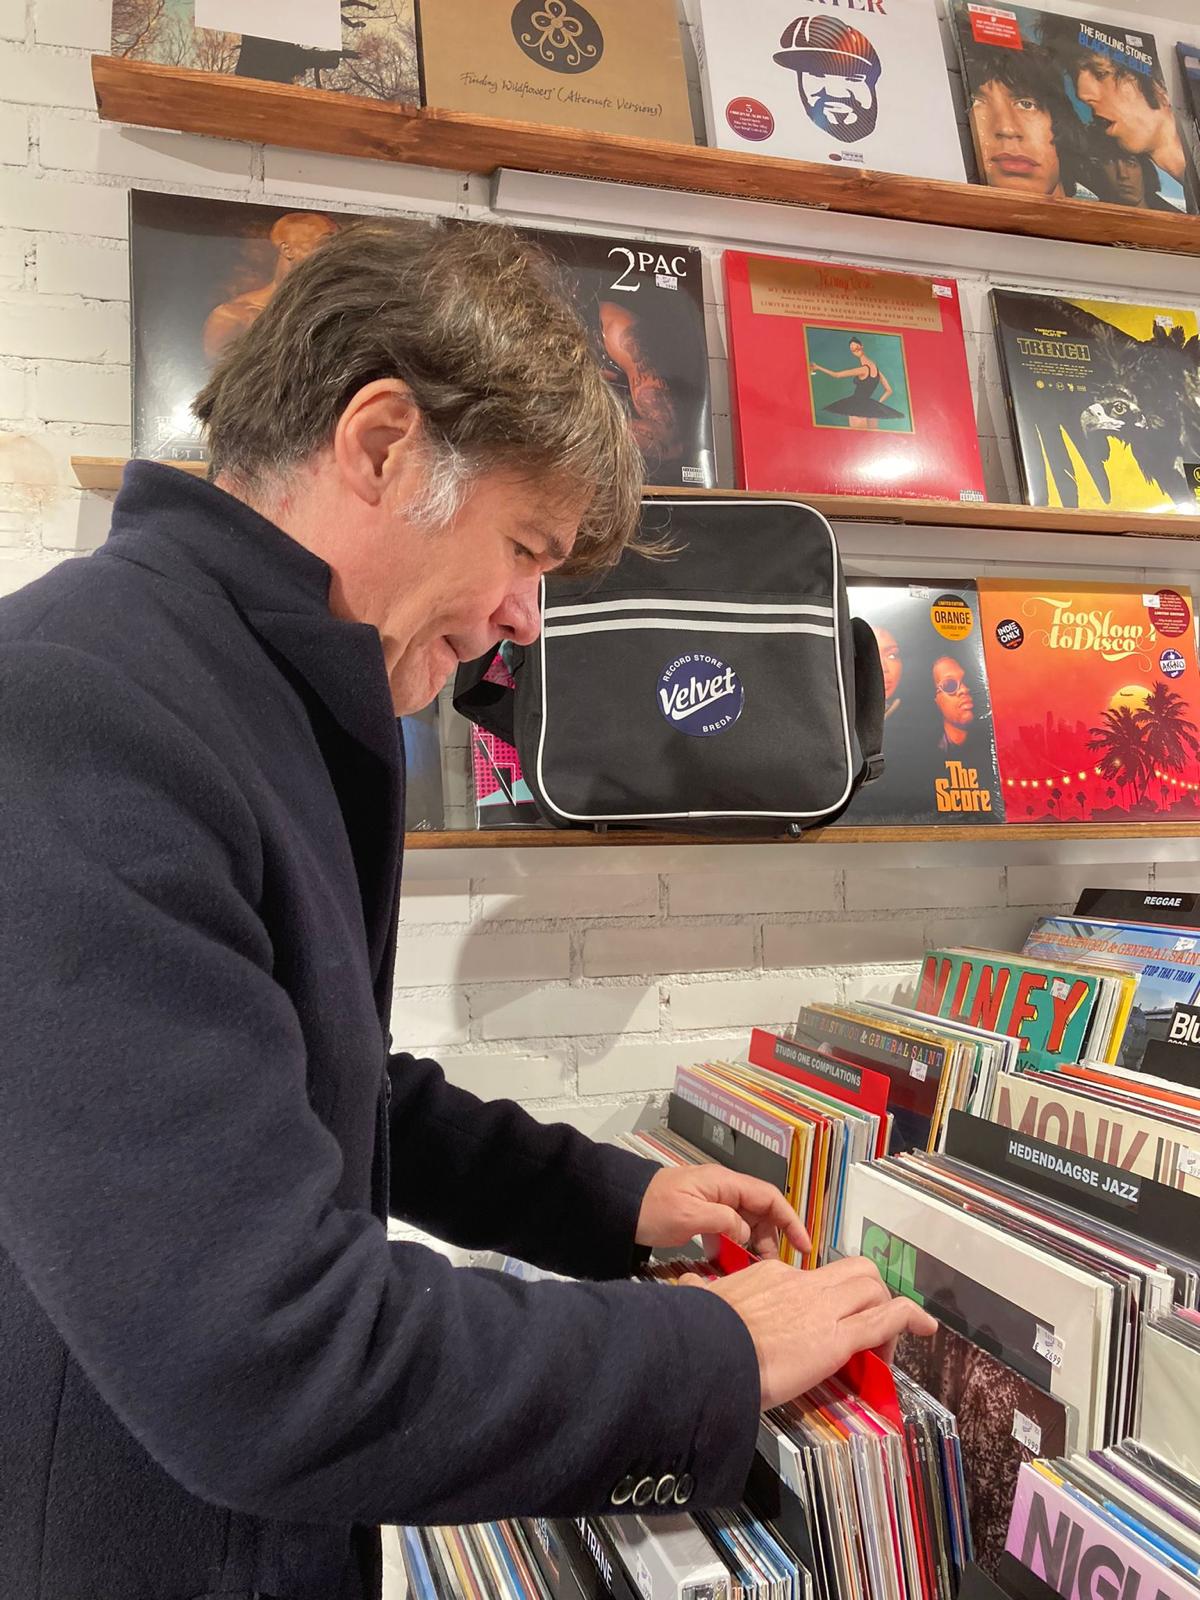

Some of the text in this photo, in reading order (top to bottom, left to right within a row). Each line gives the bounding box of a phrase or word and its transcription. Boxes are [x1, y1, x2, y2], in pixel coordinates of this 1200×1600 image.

[1079, 23, 1095, 38] THE
[1095, 29, 1125, 52] ROLLING
[1125, 45, 1153, 66] STONES
[459, 71, 498, 94] Finding
[557, 87, 613, 108] (Alternate
[616, 95, 664, 117] Versions)
[607, 247, 687, 292] 2PAC
[1016, 338, 1091, 362] TRENCH
[934, 610, 972, 624] ORANGE
[997, 622, 1018, 636] INDIE
[1088, 609, 1143, 640] Slow
[1000, 629, 1020, 643] ONLY
[1050, 624, 1073, 649] to
[1072, 627, 1136, 652] Disco
[662, 654, 724, 682] RECORD STORE
[659, 667, 736, 719] Velvet
[702, 715, 733, 733] BREDA
[944, 760, 979, 789] The
[934, 778, 992, 812] Score
[1143, 896, 1182, 907] REGGAE
[1168, 950, 1200, 966] SAIN
[1142, 964, 1197, 984] STOP THAT TRAIN
[914, 956, 1091, 1054] NINEY
[1169, 1012, 1200, 1044] Blu
[860, 1030, 868, 1044] &
[868, 1032, 909, 1057] GENERAL
[911, 1045, 943, 1068] SAINT
[775, 1043, 862, 1087] STUDIO ONE COMPILATIONS
[997, 1086, 1150, 1173] MONK
[1008, 1140, 1140, 1203] HEDENDAAGSE JAZZ
[1044, 1349, 1062, 1366] 2699
[1024, 1436, 1039, 1452] 1999
[1021, 1491, 1171, 1600] NIG
